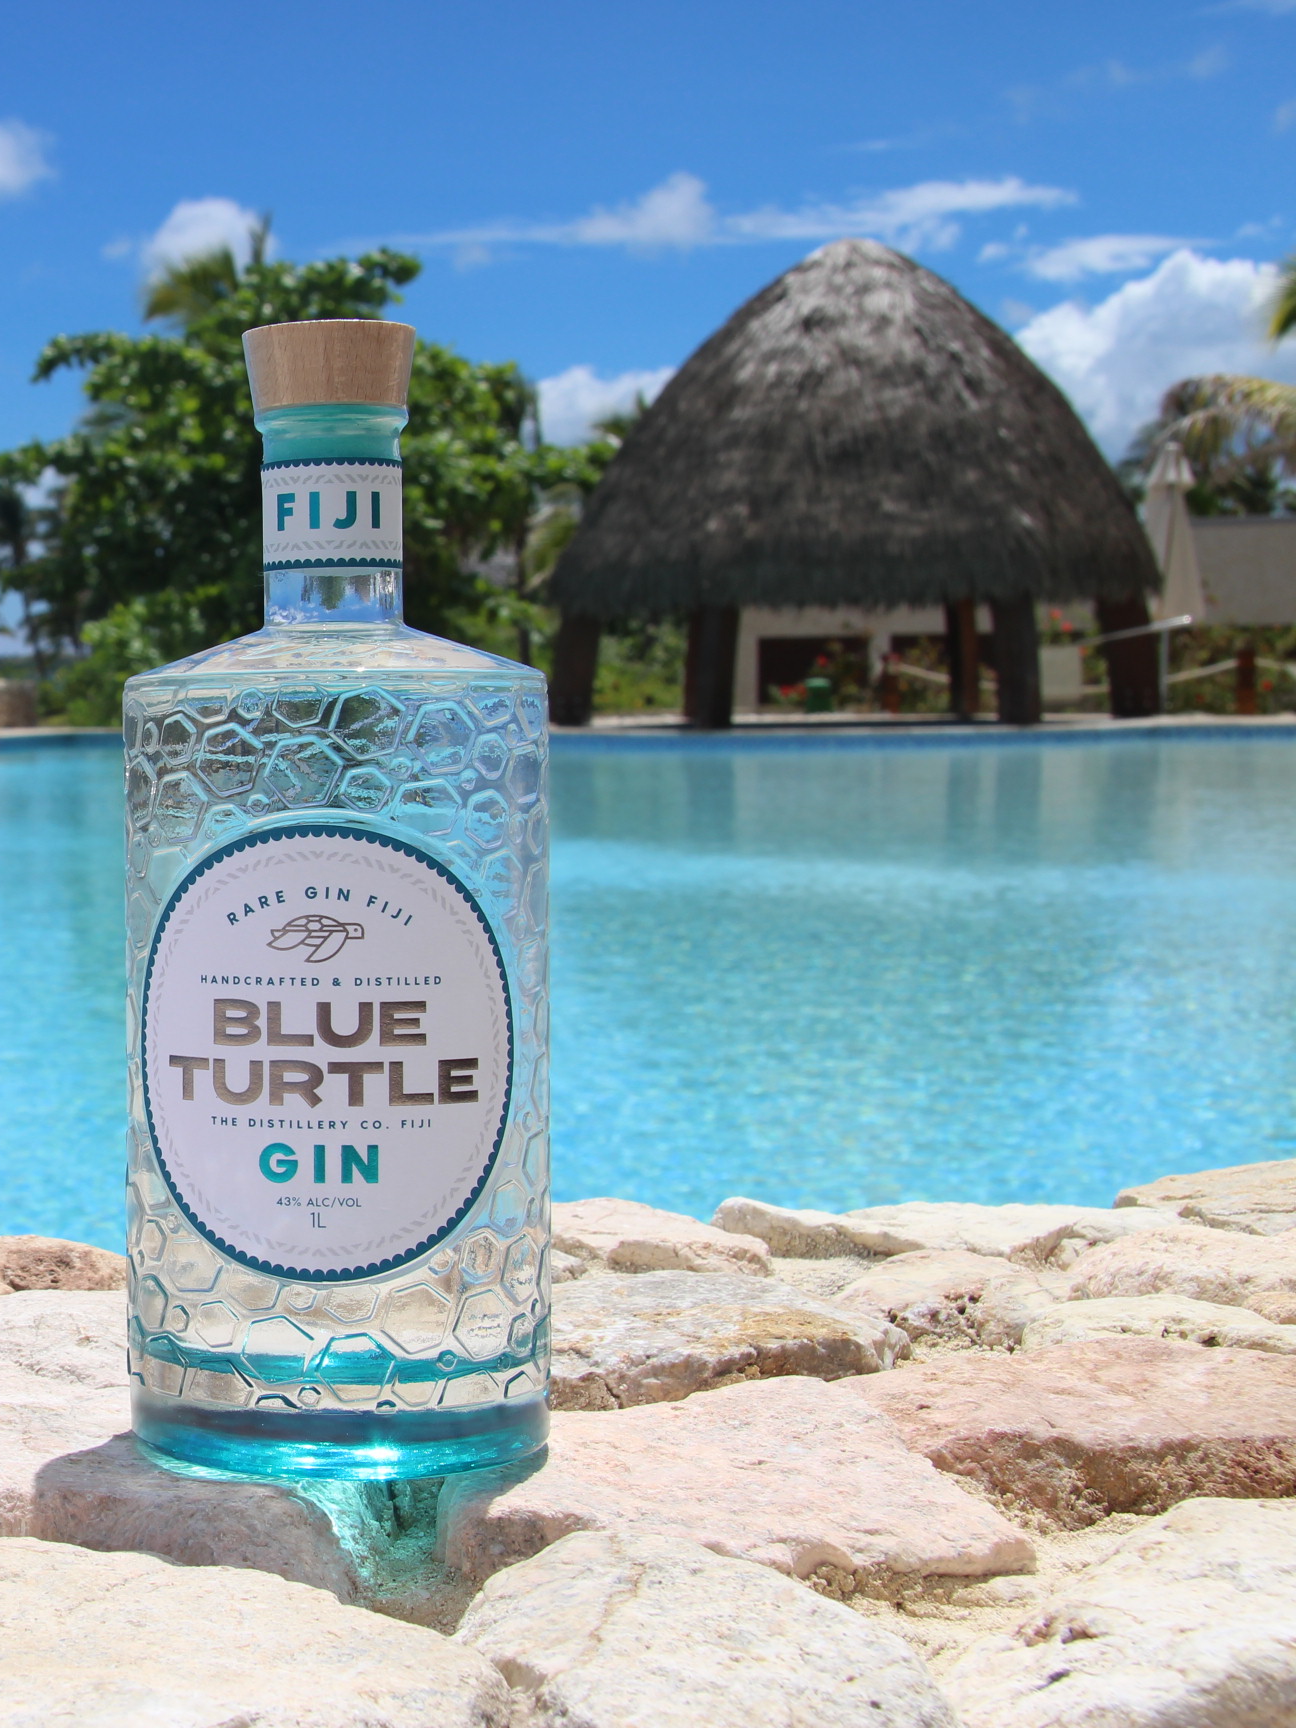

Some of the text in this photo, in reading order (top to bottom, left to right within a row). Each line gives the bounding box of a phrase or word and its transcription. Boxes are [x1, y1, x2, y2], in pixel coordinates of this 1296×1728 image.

[276, 490, 381, 531] FIJI
[226, 886, 413, 927] RARE GIN FIJI
[200, 974, 442, 987] HANDCRAFTED & DISTILLED
[213, 998, 427, 1048] BLUE
[168, 1054, 479, 1108] TURTLE
[211, 1115, 431, 1130] THE DISTILLERY CO. FIJI
[258, 1142, 379, 1184] GIN
[276, 1196, 362, 1209] 43% ALC/VOL
[310, 1211, 327, 1229] 1L
